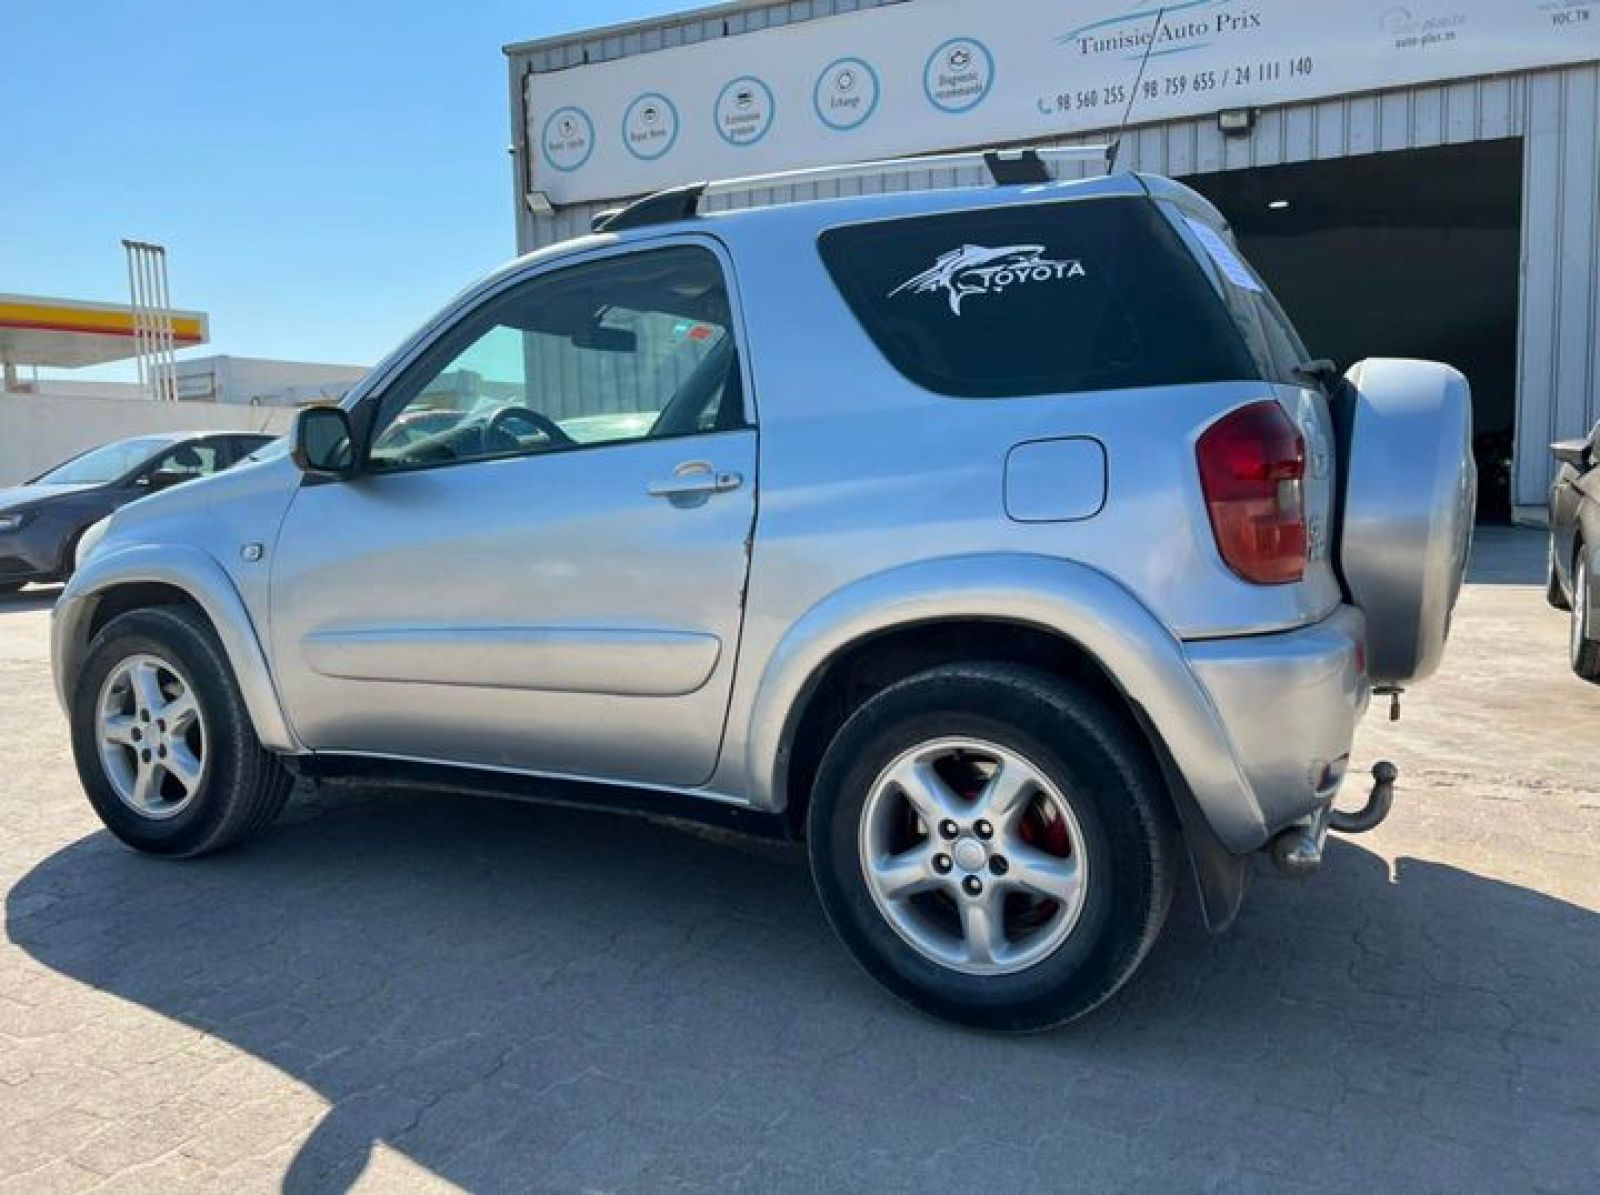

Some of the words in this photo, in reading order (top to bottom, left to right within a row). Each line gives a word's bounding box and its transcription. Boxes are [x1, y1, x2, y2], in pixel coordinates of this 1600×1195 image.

[1157, 22, 1209, 42] Auto
[1215, 11, 1262, 33] Prix
[1103, 85, 1125, 105] 255
[1143, 80, 1159, 99] 98
[1165, 75, 1187, 95] 759
[1193, 70, 1214, 92] 655
[1235, 64, 1250, 85] 24
[1290, 56, 1313, 77] 140
[981, 262, 1086, 288] TOYOTA
